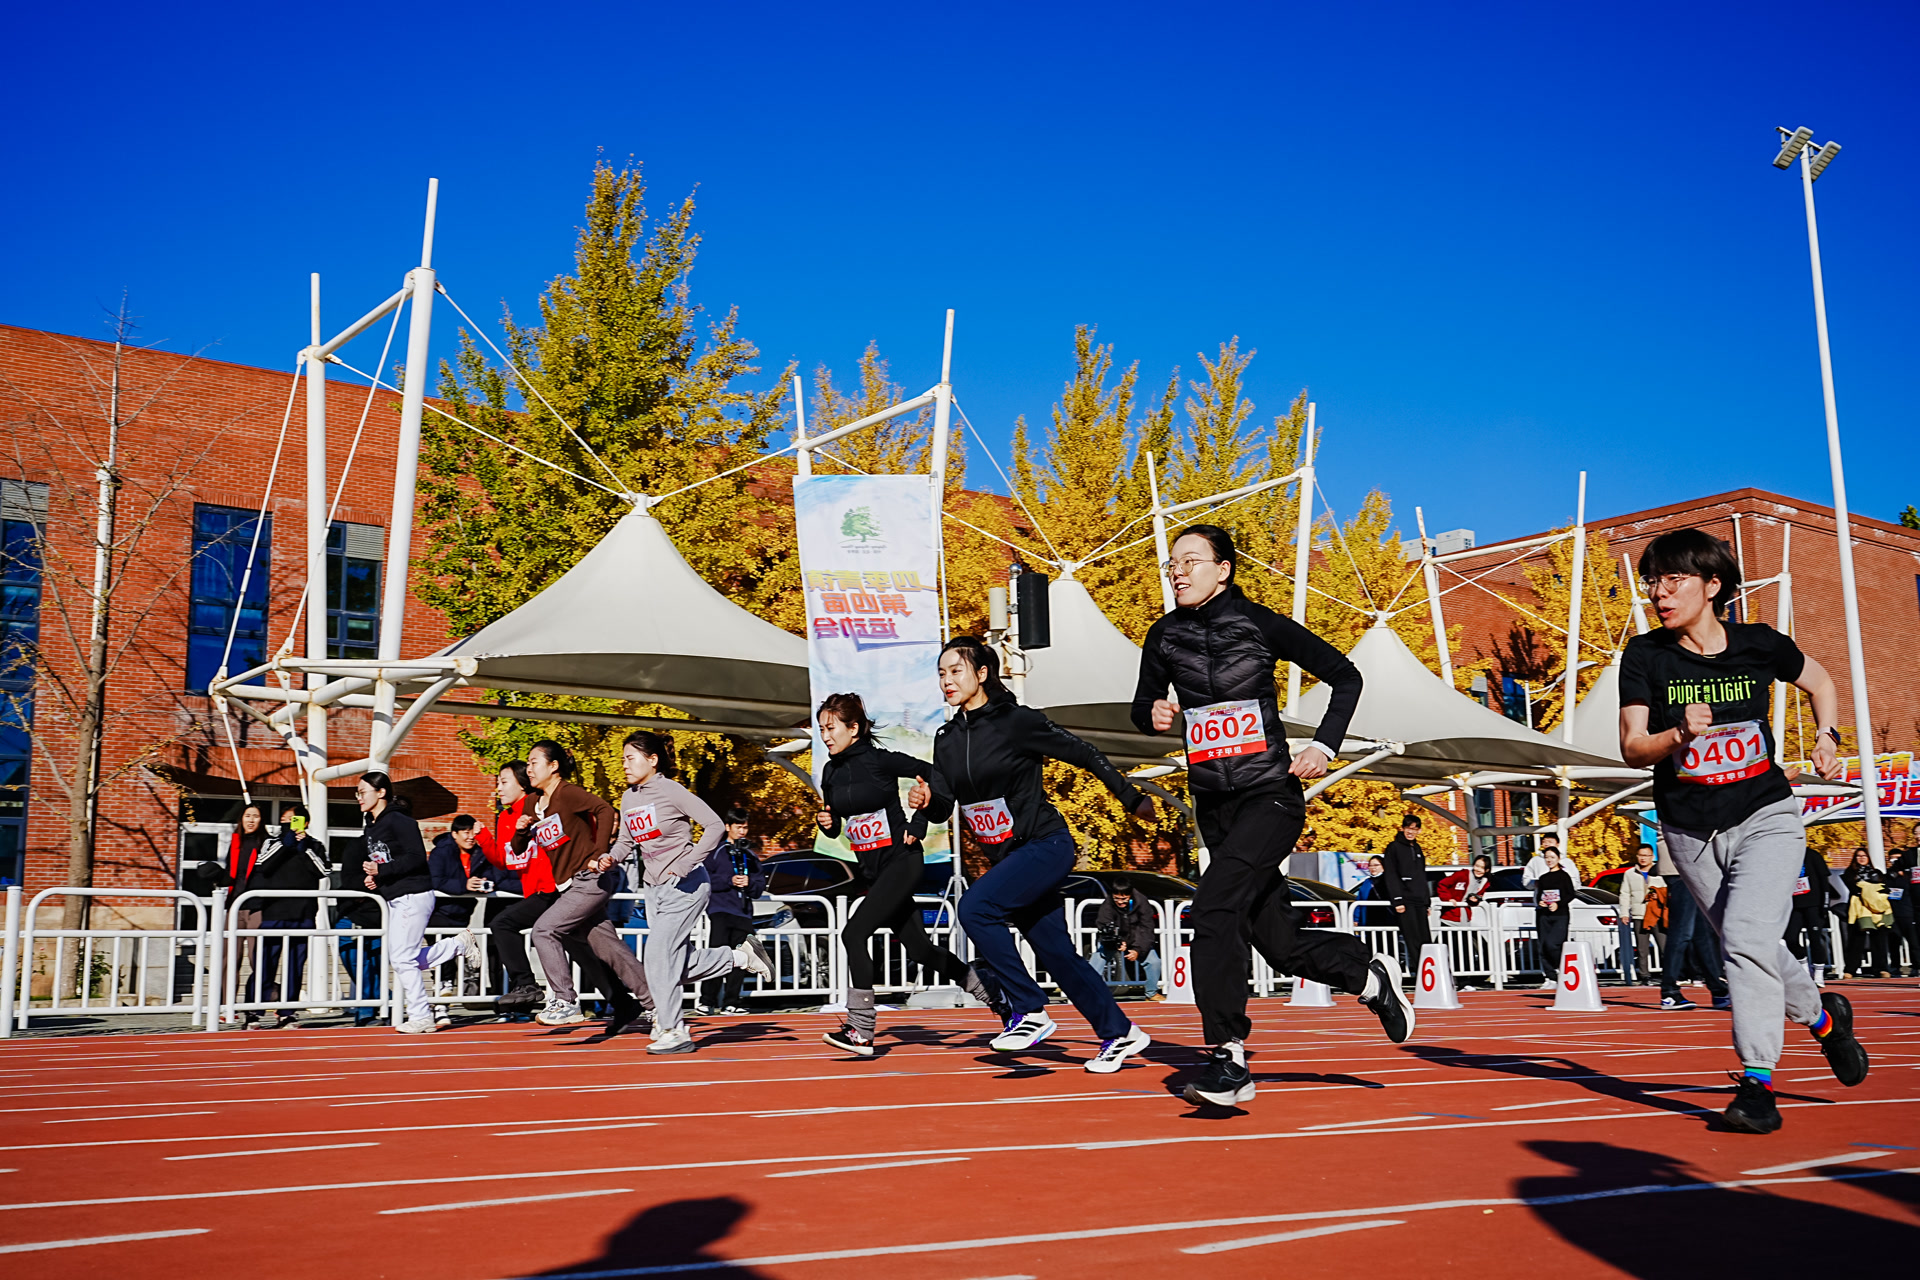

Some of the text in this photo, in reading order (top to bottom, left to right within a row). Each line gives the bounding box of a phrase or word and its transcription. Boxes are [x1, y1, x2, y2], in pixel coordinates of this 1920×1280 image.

[1668, 684, 1702, 705] PURE
[1711, 680, 1751, 703] LIGHT
[1190, 713, 1259, 745] 0602
[1680, 733, 1761, 770] 0401
[847, 820, 885, 840] 1102
[1174, 956, 1186, 988] 8
[1421, 956, 1436, 991] 6
[1564, 953, 1580, 991] 5
